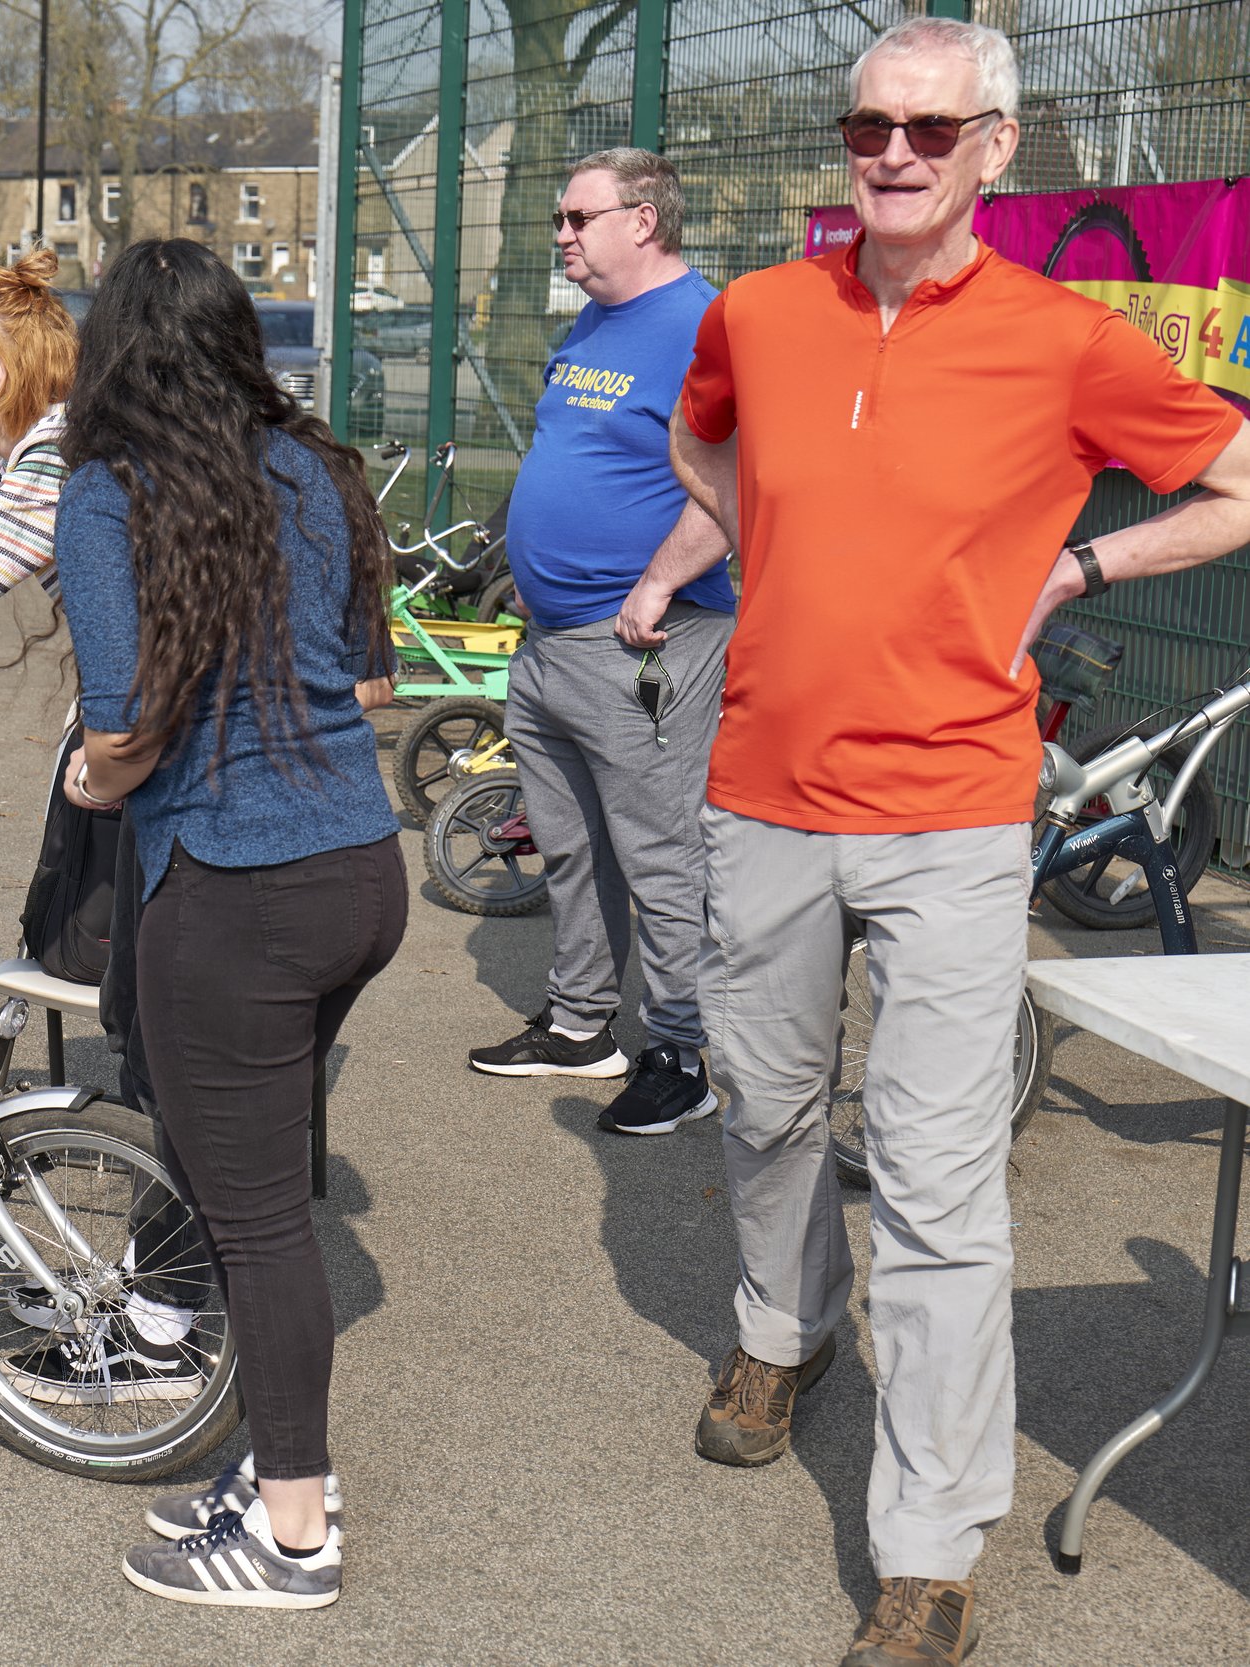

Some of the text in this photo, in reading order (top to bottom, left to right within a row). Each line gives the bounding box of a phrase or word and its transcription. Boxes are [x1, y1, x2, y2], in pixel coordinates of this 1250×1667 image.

[1198, 307, 1224, 359] 4
[563, 365, 635, 397] FAMOUS
[566, 396, 578, 406] on
[1168, 880, 1186, 924] vanraam
[35, 1442, 66, 1459] CRUISER
[65, 1455, 88, 1466] ROAD
[130, 1447, 174, 1467] SCHWALBE
